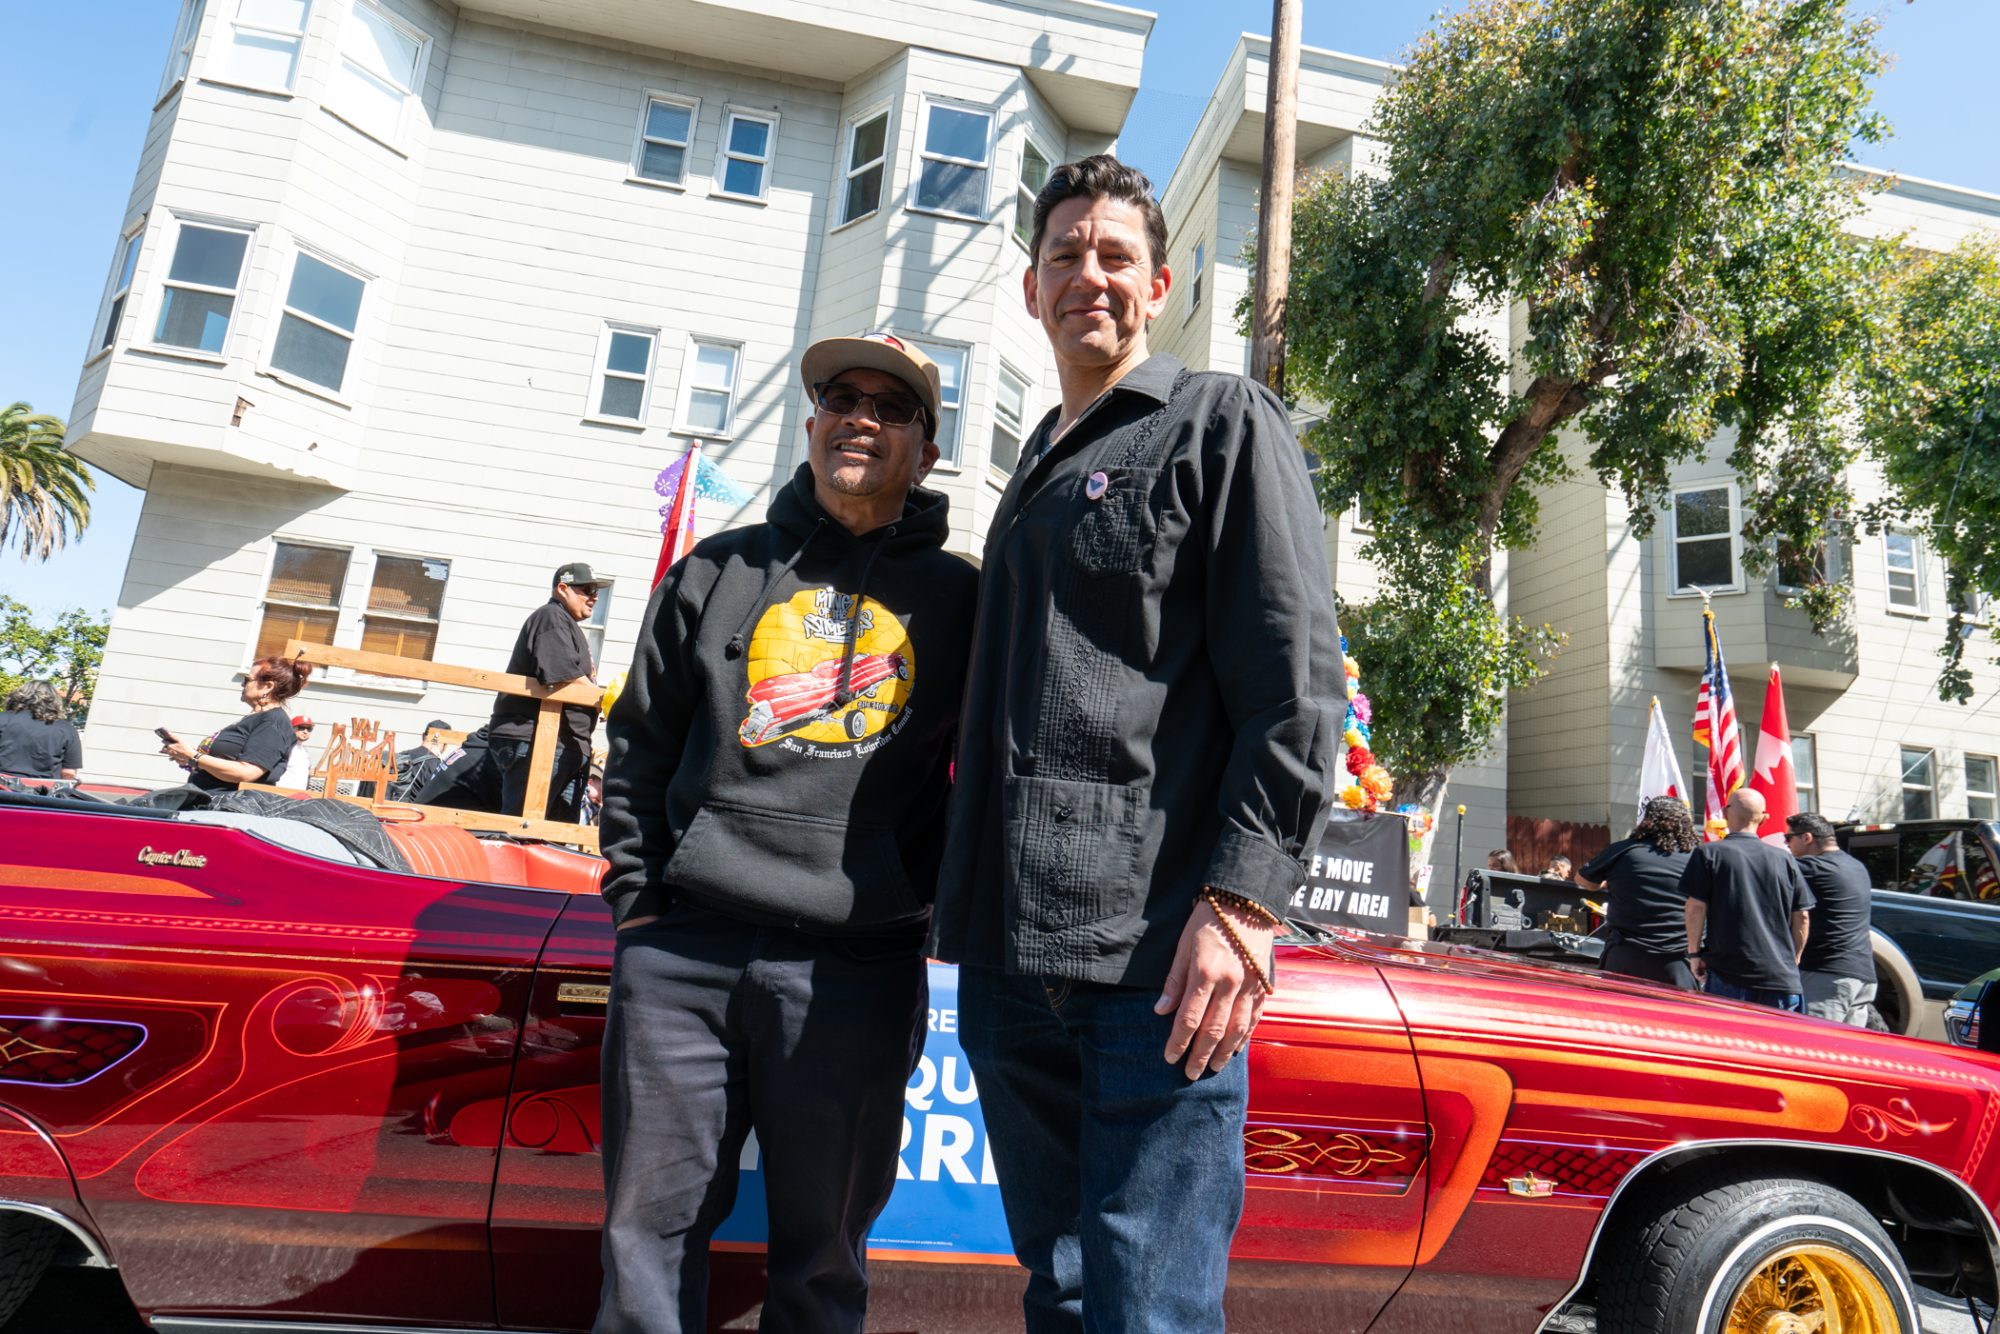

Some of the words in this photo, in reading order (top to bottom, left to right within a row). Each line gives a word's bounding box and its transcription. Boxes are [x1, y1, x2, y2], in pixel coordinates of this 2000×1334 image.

[778, 737, 803, 754] San
[803, 744, 852, 760] Francisco
[853, 733, 893, 759] Lowrider
[138, 845, 173, 866] Caprice
[173, 849, 207, 868] Classic
[1325, 857, 1374, 884] MOVE
[1309, 887, 1345, 912] BAY
[1347, 892, 1390, 918] AREA
